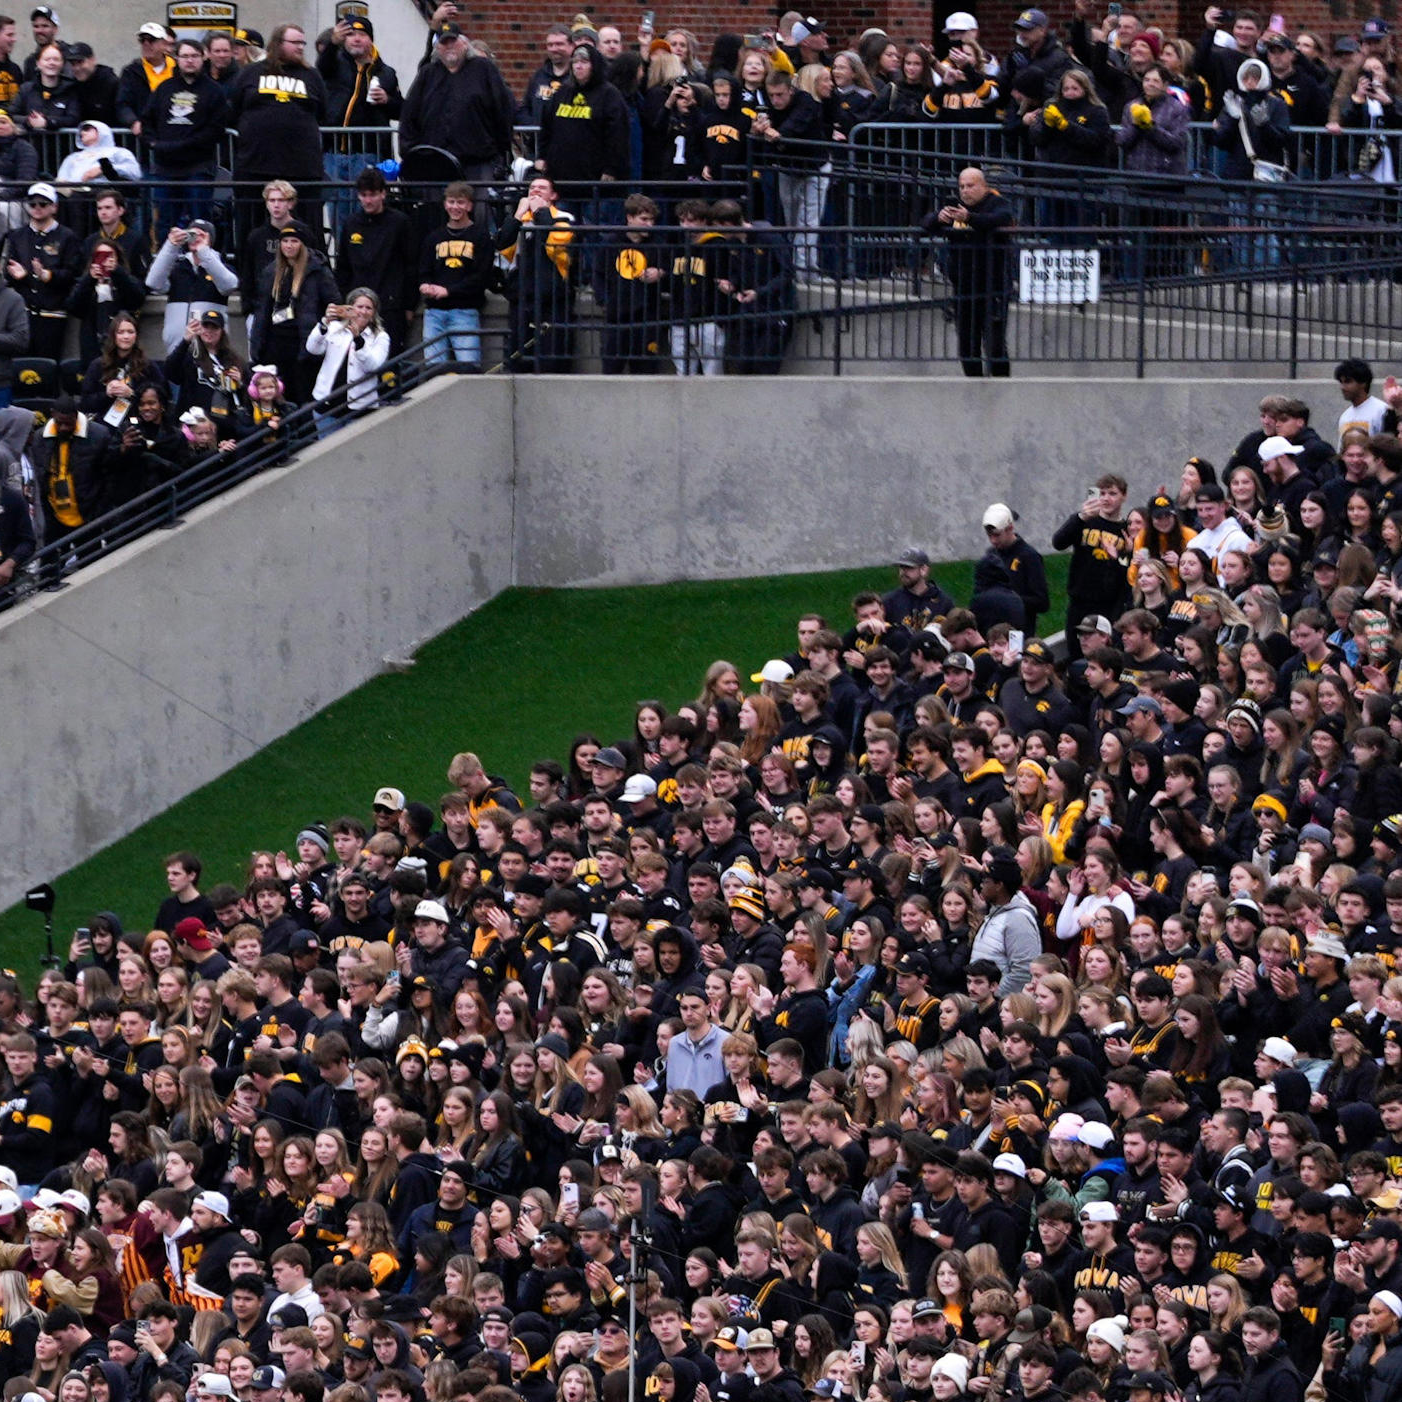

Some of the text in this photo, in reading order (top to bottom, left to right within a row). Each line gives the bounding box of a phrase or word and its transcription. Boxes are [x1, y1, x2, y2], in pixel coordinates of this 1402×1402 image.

[259, 76, 308, 94] IOWA
[556, 103, 593, 119] IOWA
[706, 125, 740, 142] IOWA
[673, 135, 687, 165] 1
[436, 241, 473, 258] IOWA
[1074, 1269, 1120, 1290] IOWA
